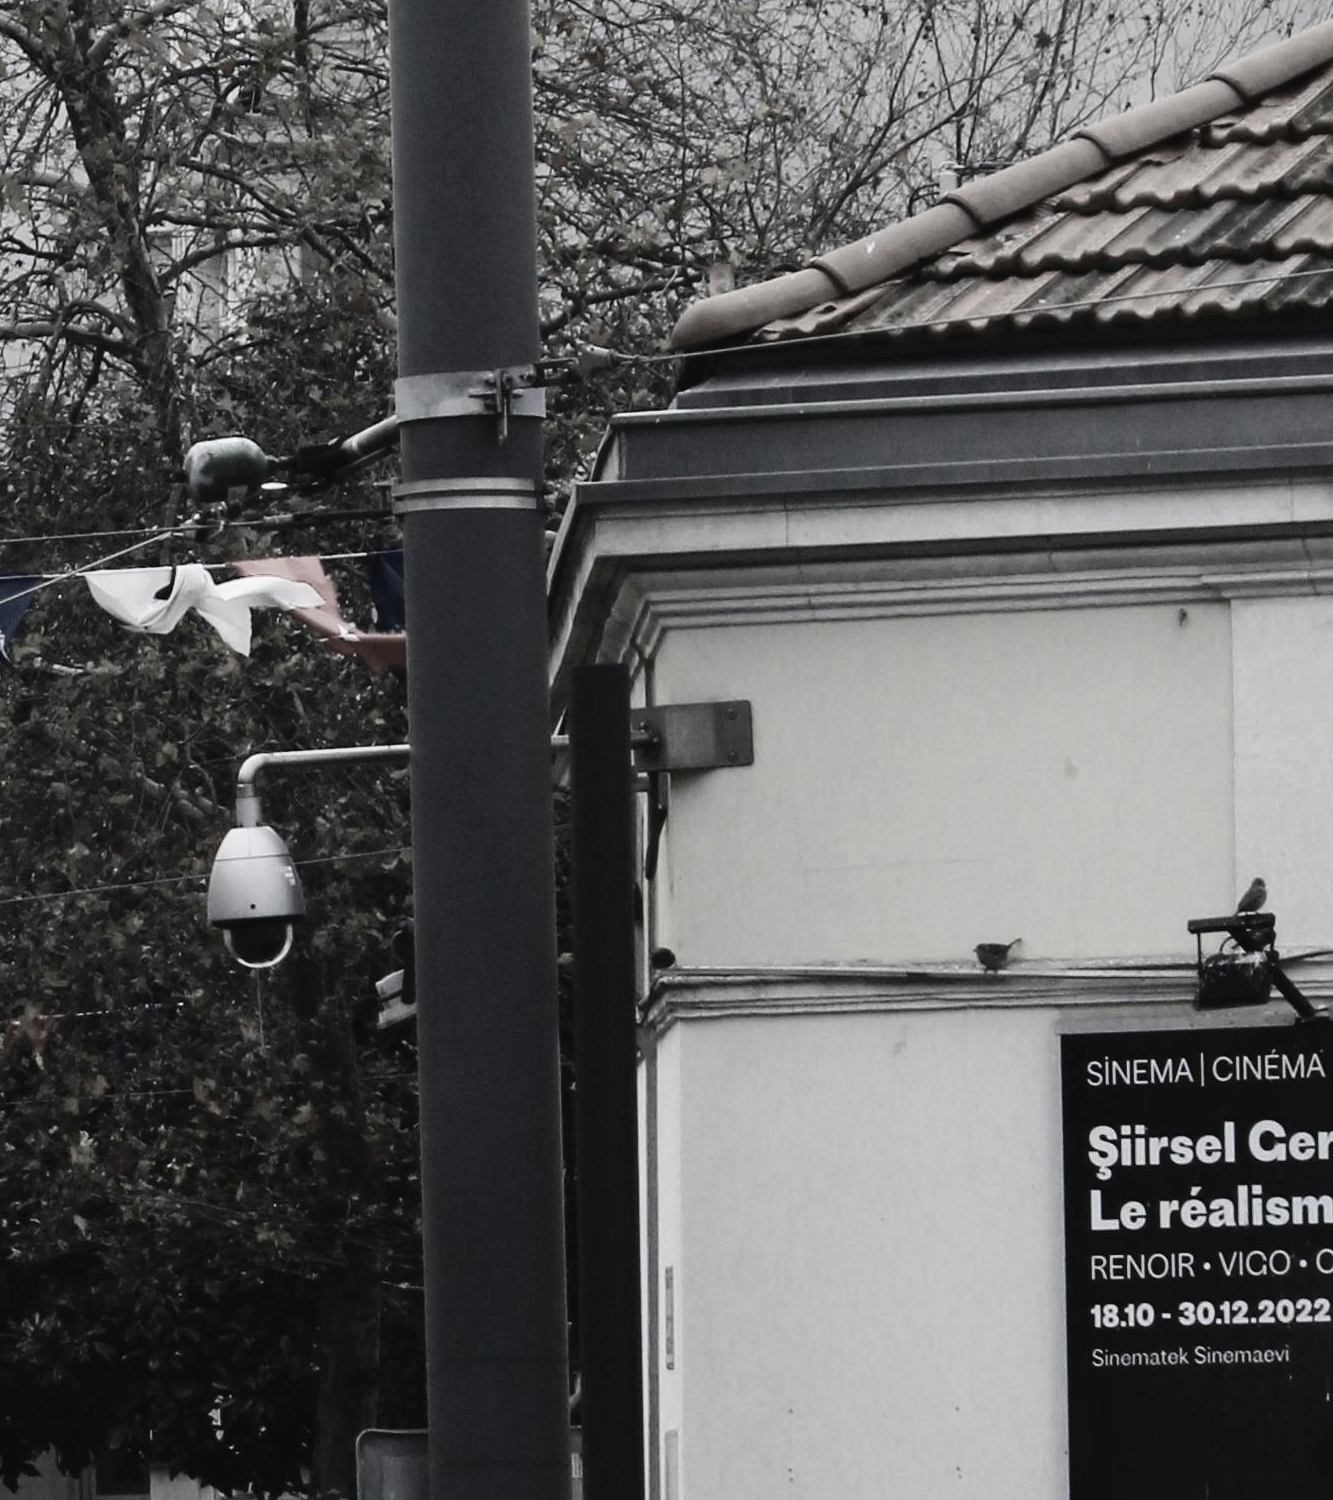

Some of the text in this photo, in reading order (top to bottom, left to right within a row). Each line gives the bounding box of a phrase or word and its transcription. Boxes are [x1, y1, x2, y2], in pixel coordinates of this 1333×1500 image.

[1086, 1049, 1326, 1086] SİNEMA CINÉMA
[1088, 1121, 1235, 1181] Şiirsel
[1090, 1189, 1147, 1231] Le
[1091, 1252, 1195, 1280] RENOIR
[1219, 1250, 1291, 1277] VIGO
[1090, 1303, 1155, 1328] 18.10
[1178, 1299, 1331, 1324] 30.12.2022
[1091, 1345, 1291, 1368] Sinematek Sinemaevi
